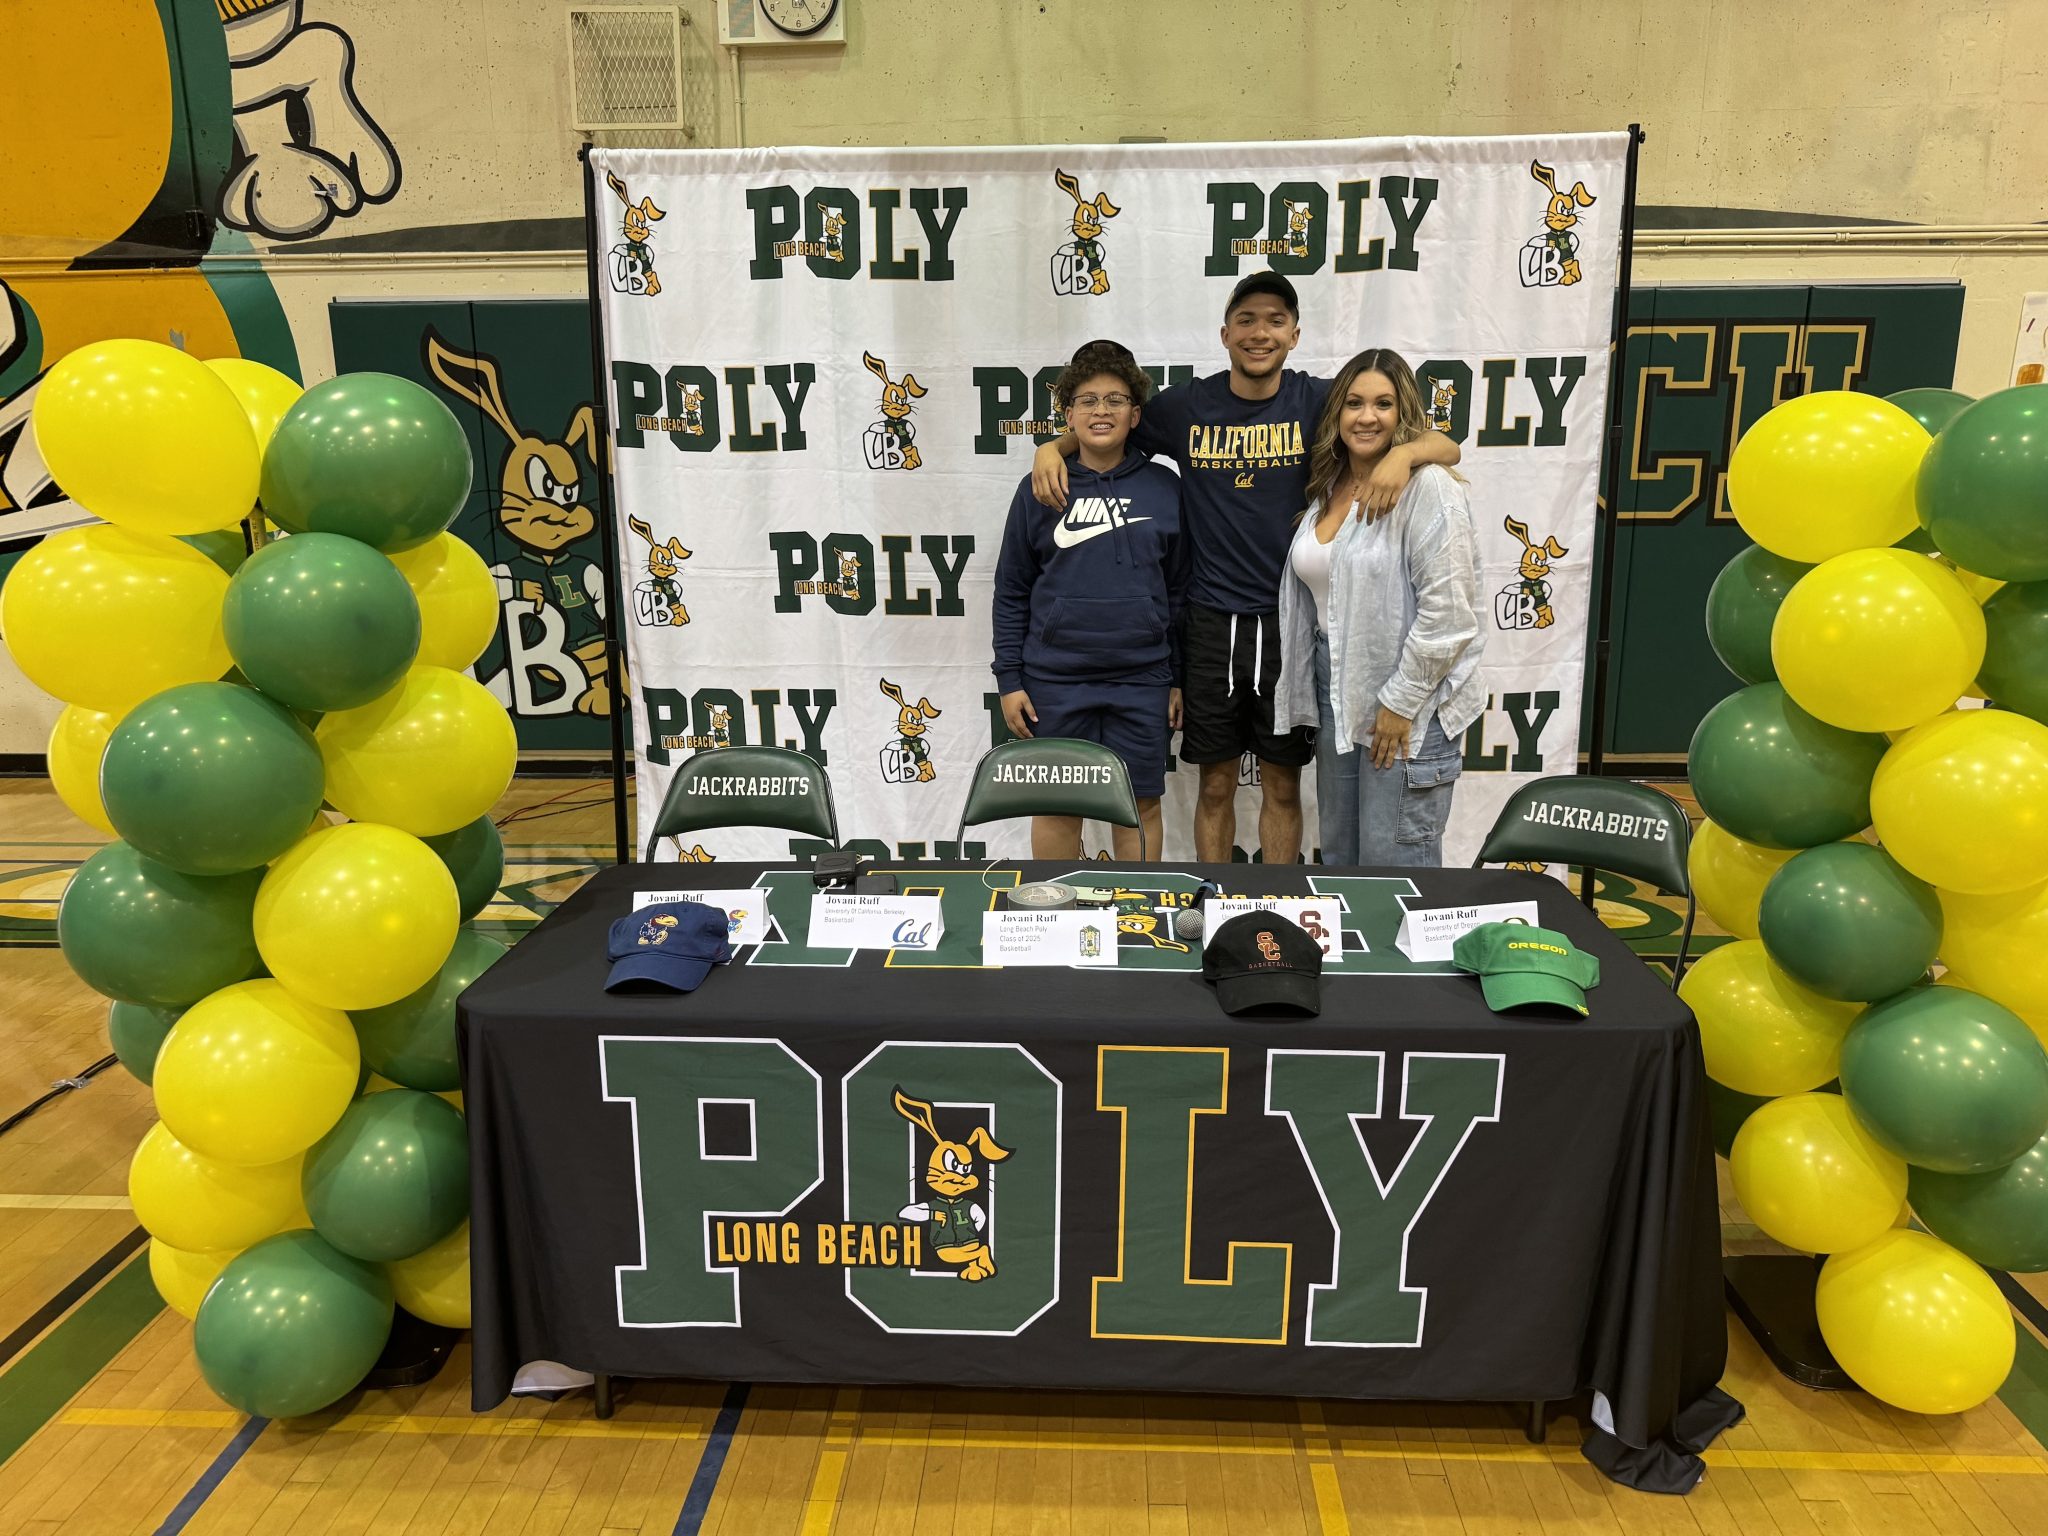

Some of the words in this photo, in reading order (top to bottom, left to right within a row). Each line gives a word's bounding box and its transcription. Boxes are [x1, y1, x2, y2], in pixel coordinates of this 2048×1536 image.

[769, 4, 775, 12] 8
[780, 15, 786, 24] 7
[795, 20, 802, 28] 6
[811, 15, 817, 23] 5
[745, 185, 968, 281] POLY
[1204, 175, 1439, 277] POLY
[774, 240, 796, 258] LONG
[798, 241, 827, 258] BEACH
[1232, 240, 1257, 255] LONG
[1259, 239, 1290, 255] BEACH
[612, 361, 816, 453] POLY
[1415, 356, 1587, 448] OLY
[637, 414, 660, 431] LONG
[661, 416, 688, 433] BEACH
[1000, 420, 1024, 435] LONG
[1026, 420, 1054, 435] BEACH
[1188, 420, 1306, 459] CALIFORNIA
[1191, 456, 1302, 469] BASKETBALL
[1234, 472, 1255, 488] Cal
[1066, 497, 1132, 526] NIKE
[769, 531, 976, 617] POLY
[794, 580, 815, 595] LONG
[817, 581, 844, 597] BEACH
[642, 686, 837, 767] POLY
[661, 735, 685, 750] LONG
[686, 735, 715, 750] BEACH
[993, 764, 1112, 784] JACKRABBITS
[687, 775, 810, 796] JACKRABBITS
[1523, 801, 1670, 842] JACKRABBITS
[647, 893, 679, 903] Jovani
[682, 893, 705, 902] Ruff
[825, 896, 856, 905] Jovani
[859, 896, 881, 905] Ruff
[1219, 901, 1252, 910] Jovani
[1255, 901, 1278, 910] Ruff
[825, 907, 850, 915] University
[883, 908, 905, 916] Berkeley
[1000, 914, 1033, 922] Jovani
[1036, 914, 1059, 922] Ruff
[1422, 912, 1454, 923] Jovani
[1456, 909, 1479, 919] Ruff
[891, 918, 932, 948] Cal
[999, 926, 1014, 934] Long
[1015, 925, 1034, 933] Beach
[1423, 924, 1453, 932] University
[1256, 931, 1281, 961] SC
[1425, 934, 1456, 942] Basketball
[1508, 942, 1568, 955] OREGON
[1248, 961, 1294, 969] BASKETBALL
[597, 1034, 1507, 1350] POLY
[716, 1221, 800, 1264] LONG
[817, 1223, 921, 1266] BEACH
